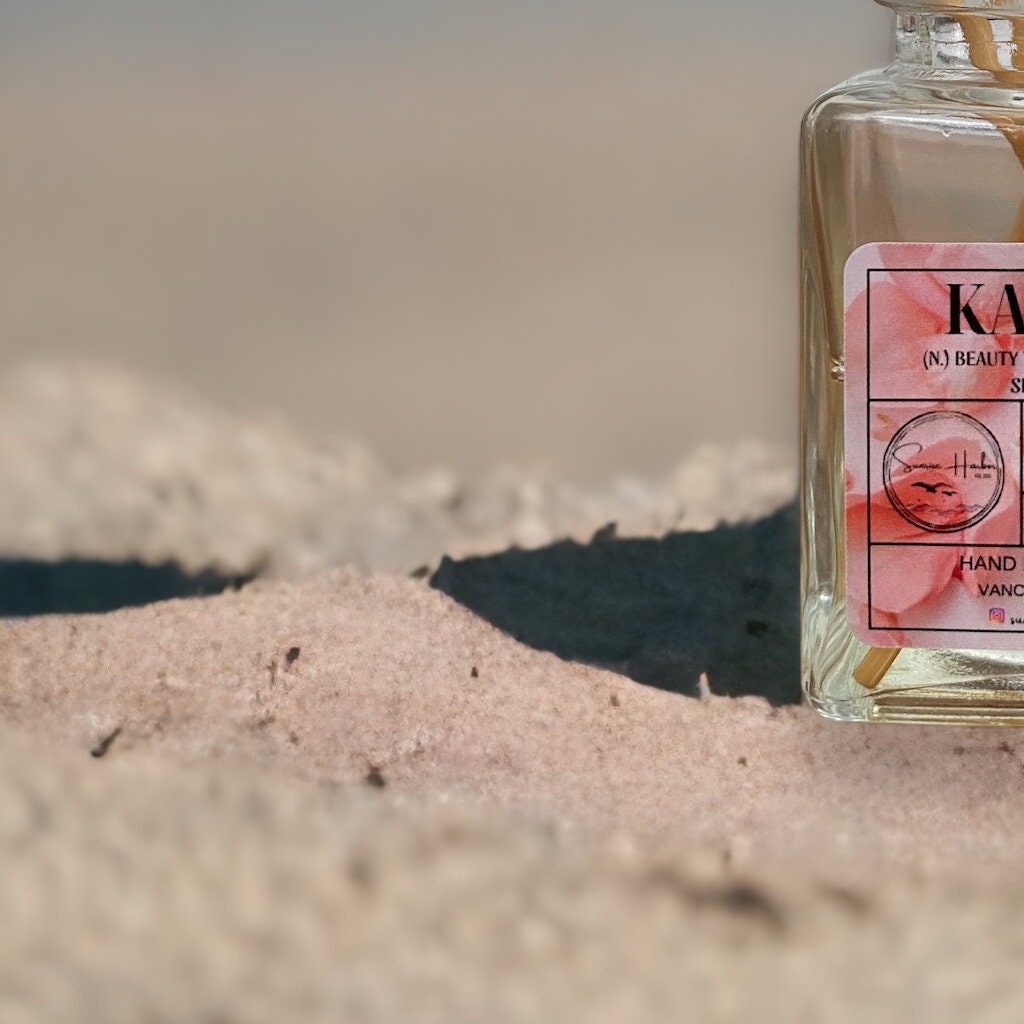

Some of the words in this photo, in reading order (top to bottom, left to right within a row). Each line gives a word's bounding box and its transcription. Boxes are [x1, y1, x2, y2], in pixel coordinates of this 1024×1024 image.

[923, 350, 949, 369] (N.)
[955, 351, 1018, 367] BEAUTY
[959, 555, 1016, 571] HAND
